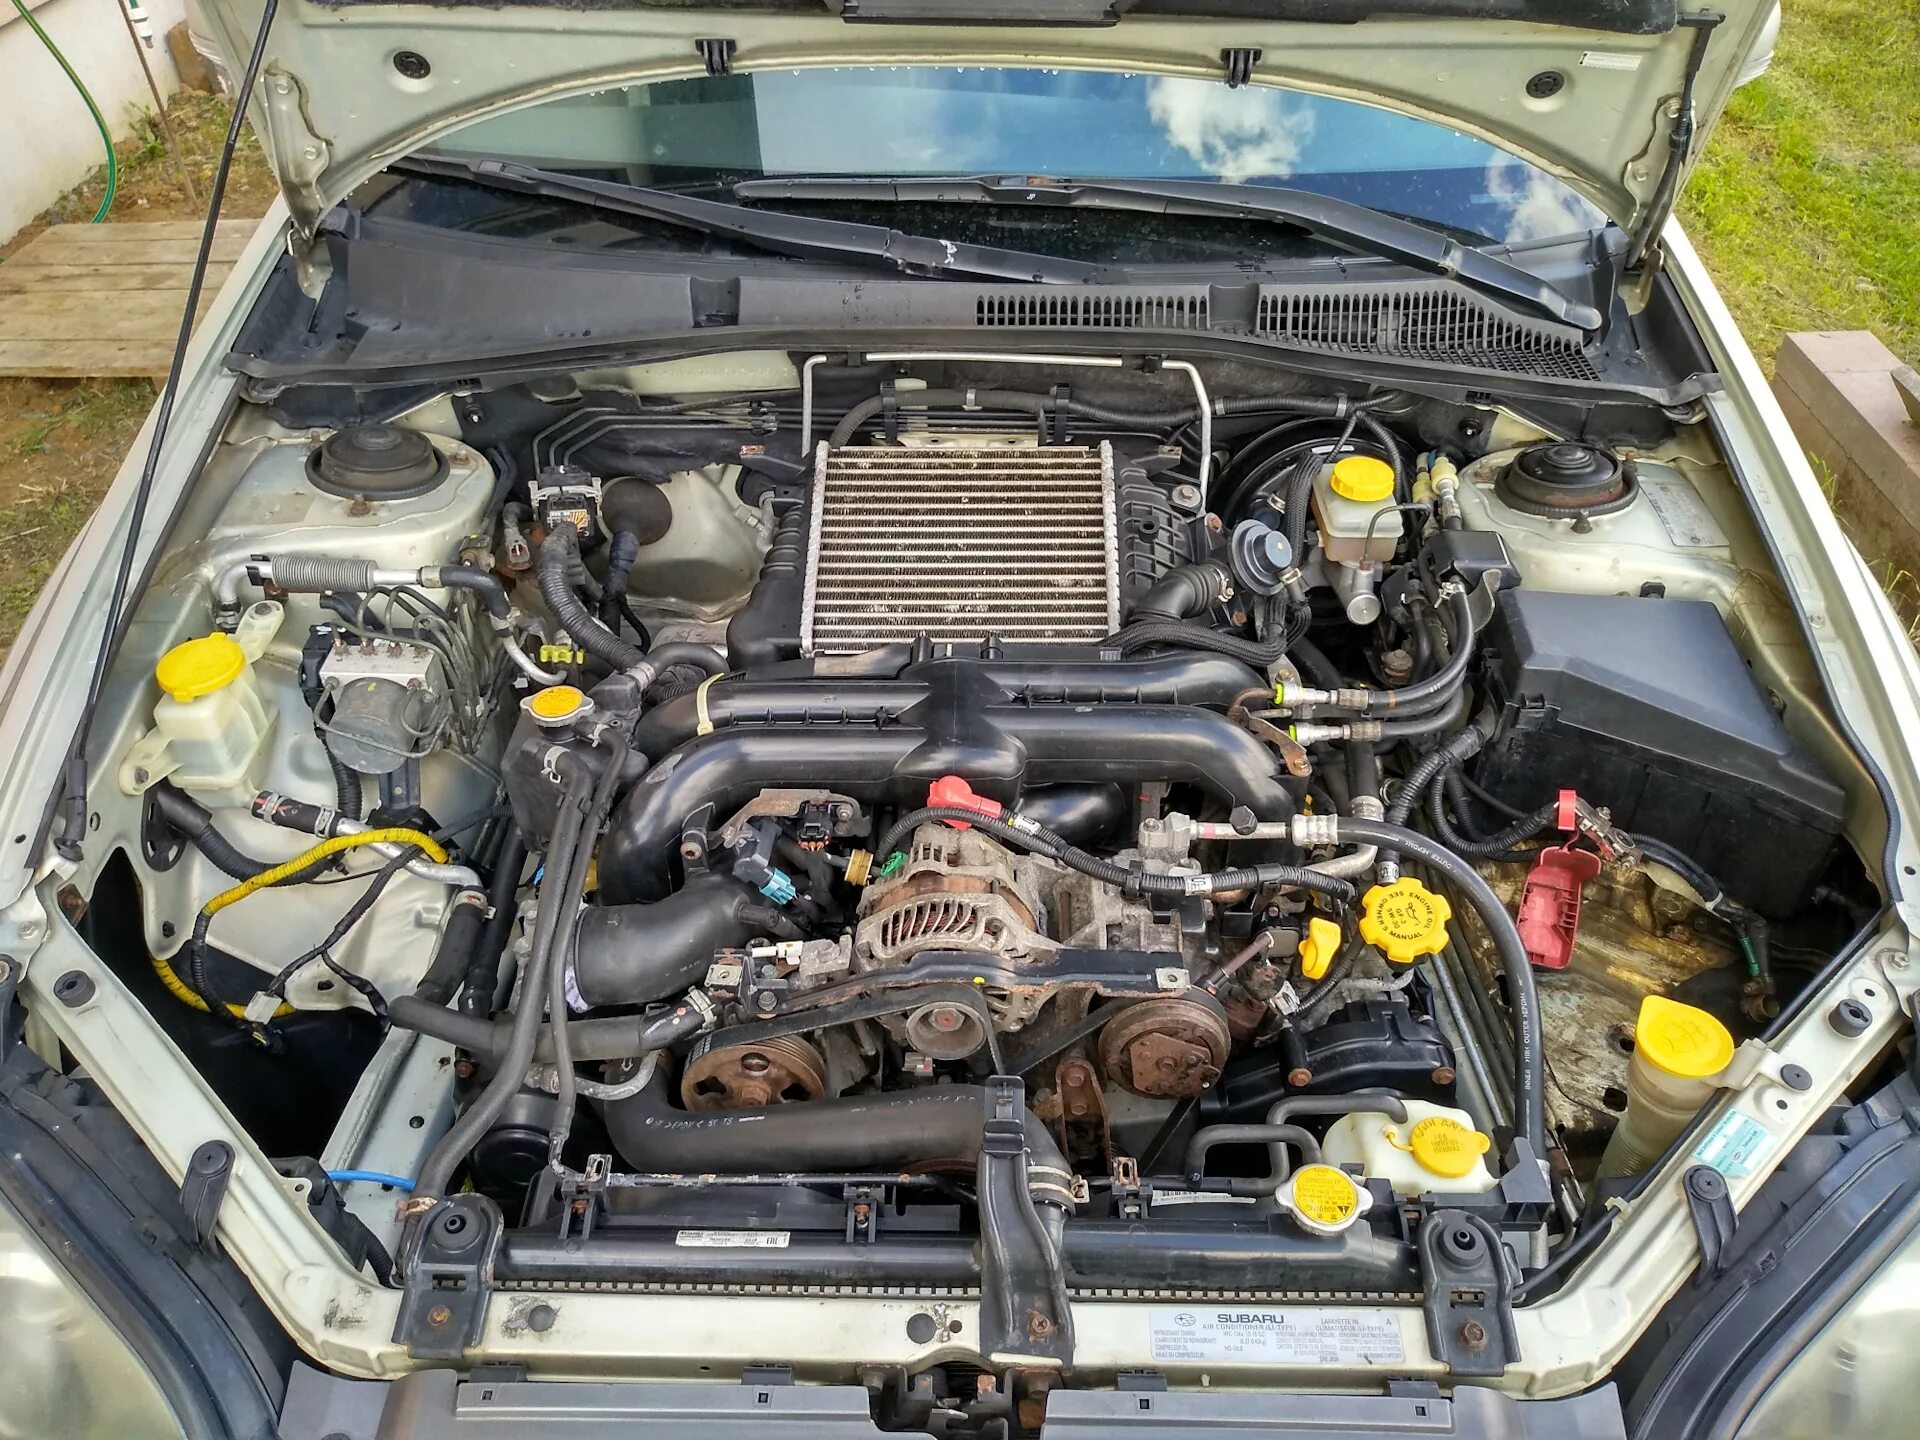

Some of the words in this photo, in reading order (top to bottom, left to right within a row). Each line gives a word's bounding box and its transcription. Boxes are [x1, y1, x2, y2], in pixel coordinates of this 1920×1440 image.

[1389, 891, 1404, 899] SEE
[1408, 892, 1433, 915] ENGINE
[1423, 919, 1433, 929] OIL
[1389, 931, 1423, 940] MANUAL
[1217, 1314, 1284, 1324] SUBARU
[1385, 1318, 1392, 1326] A
